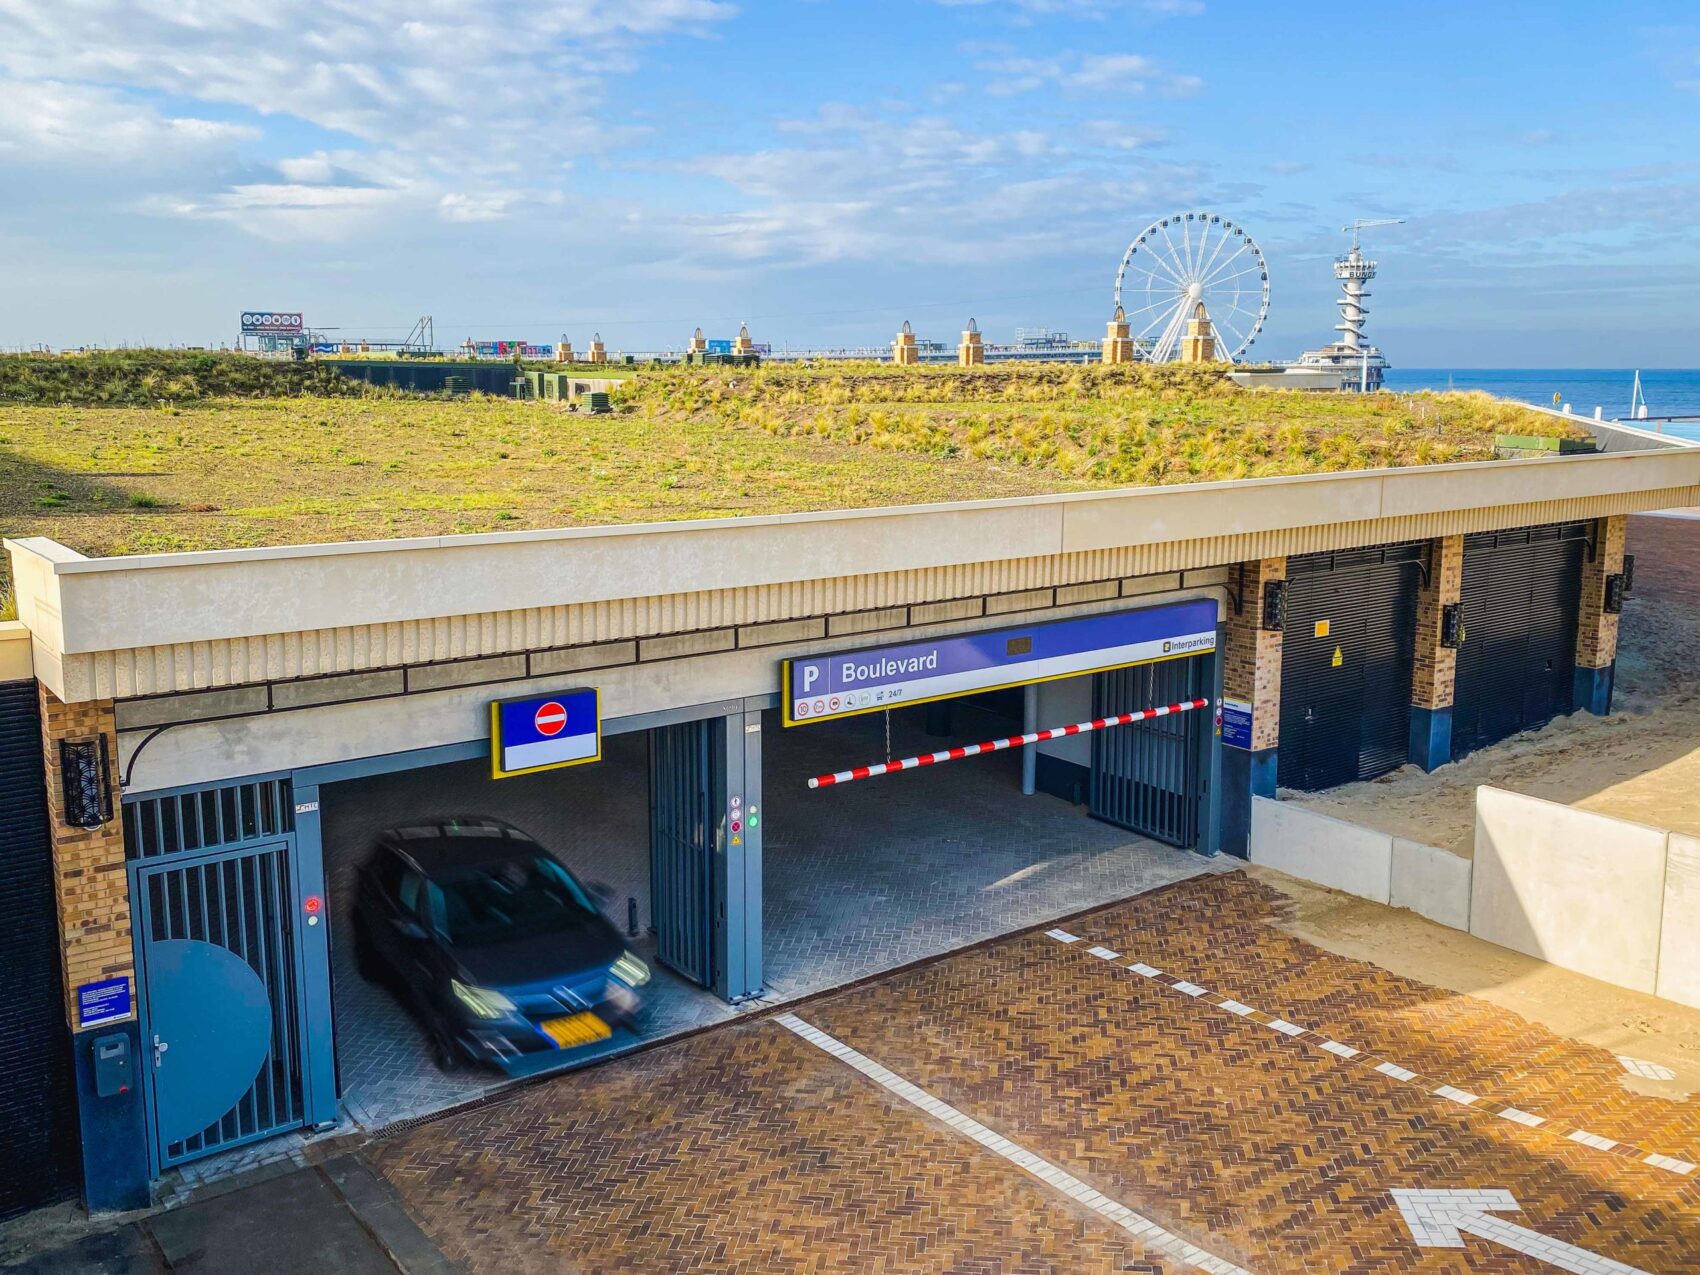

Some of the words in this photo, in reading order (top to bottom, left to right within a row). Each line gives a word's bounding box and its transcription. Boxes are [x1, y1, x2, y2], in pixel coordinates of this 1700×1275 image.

[1172, 636, 1214, 650] Interparking
[803, 665, 819, 692] P
[842, 650, 937, 682] Boulevard
[888, 689, 903, 698] 24/7
